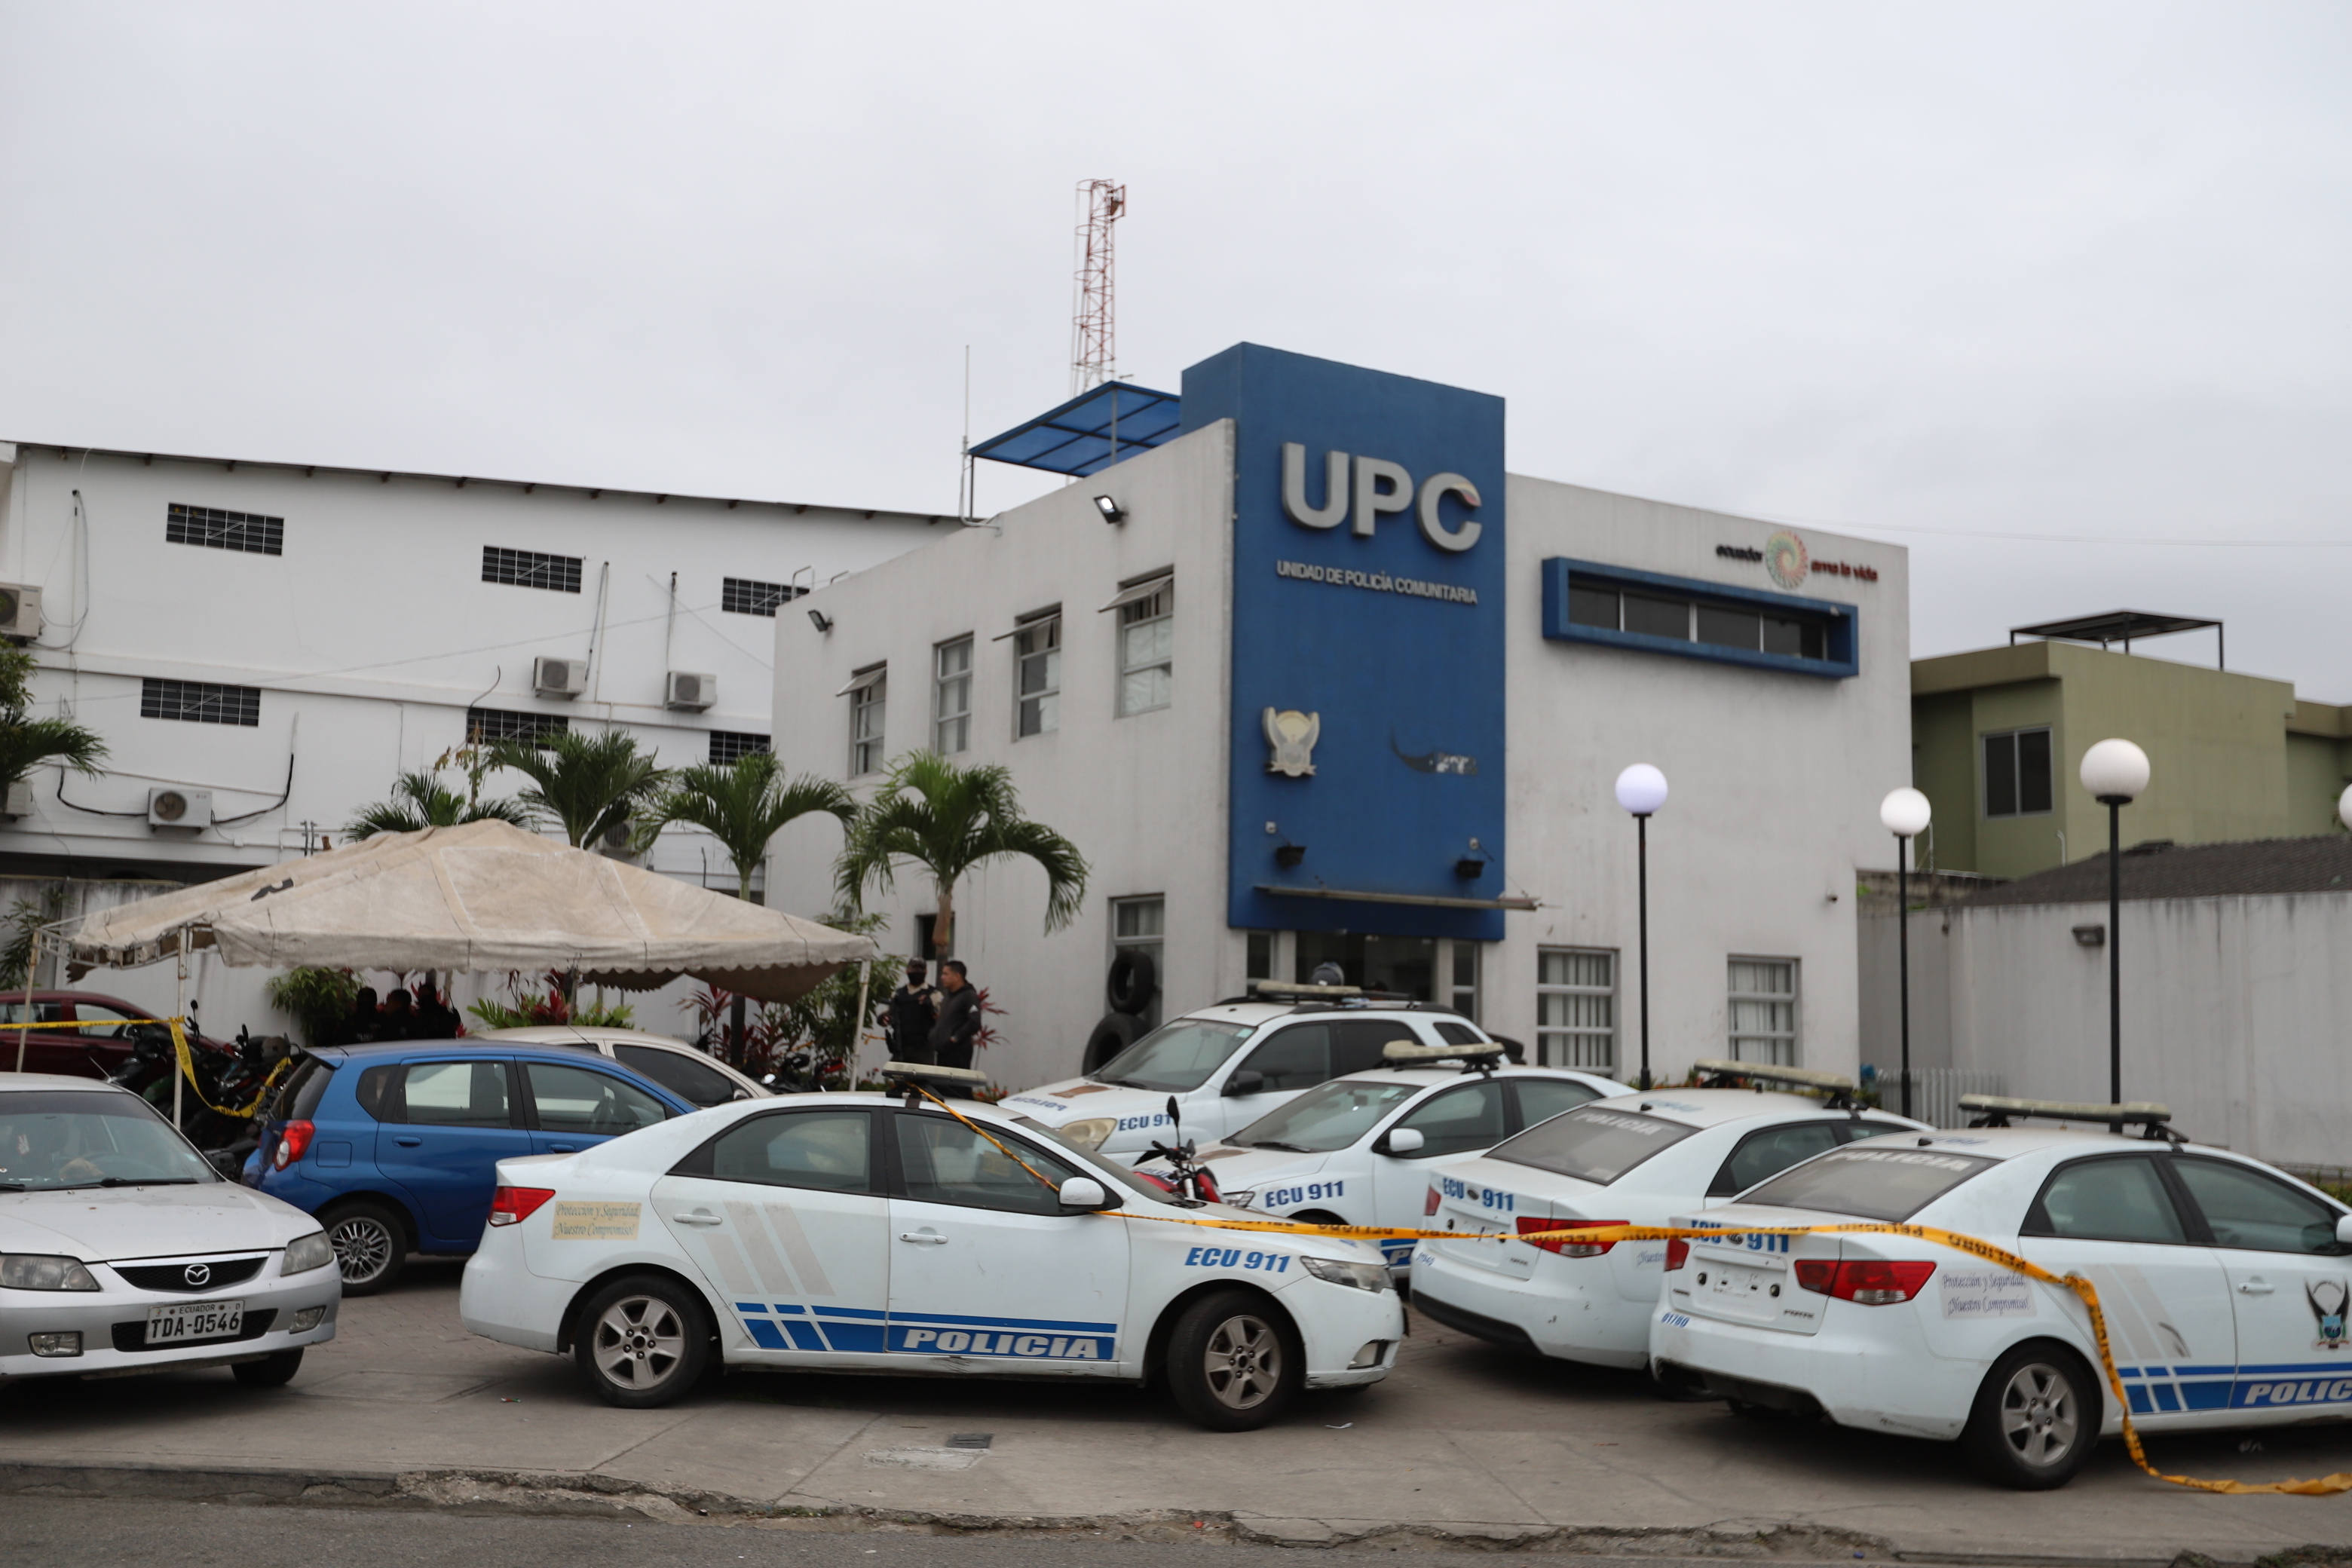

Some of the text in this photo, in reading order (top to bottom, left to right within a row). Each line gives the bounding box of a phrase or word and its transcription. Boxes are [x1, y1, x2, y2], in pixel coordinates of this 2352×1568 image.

[1282, 442, 1482, 553] UPC
[1277, 560, 1478, 605] UNIDAD DE POLICÍA COMUNITARIA
[1118, 1113, 1171, 1131] ECU 91
[1824, 1150, 1974, 1172] POLICIA
[1265, 1181, 1344, 1208] ECU 911
[1444, 1178, 1514, 1211] ECU 911
[1184, 1247, 1291, 1273] ECU 911
[179, 1304, 215, 1314] ECUADOR
[152, 1312, 240, 1338] TDA-0546
[903, 1329, 1099, 1358] POLICIA
